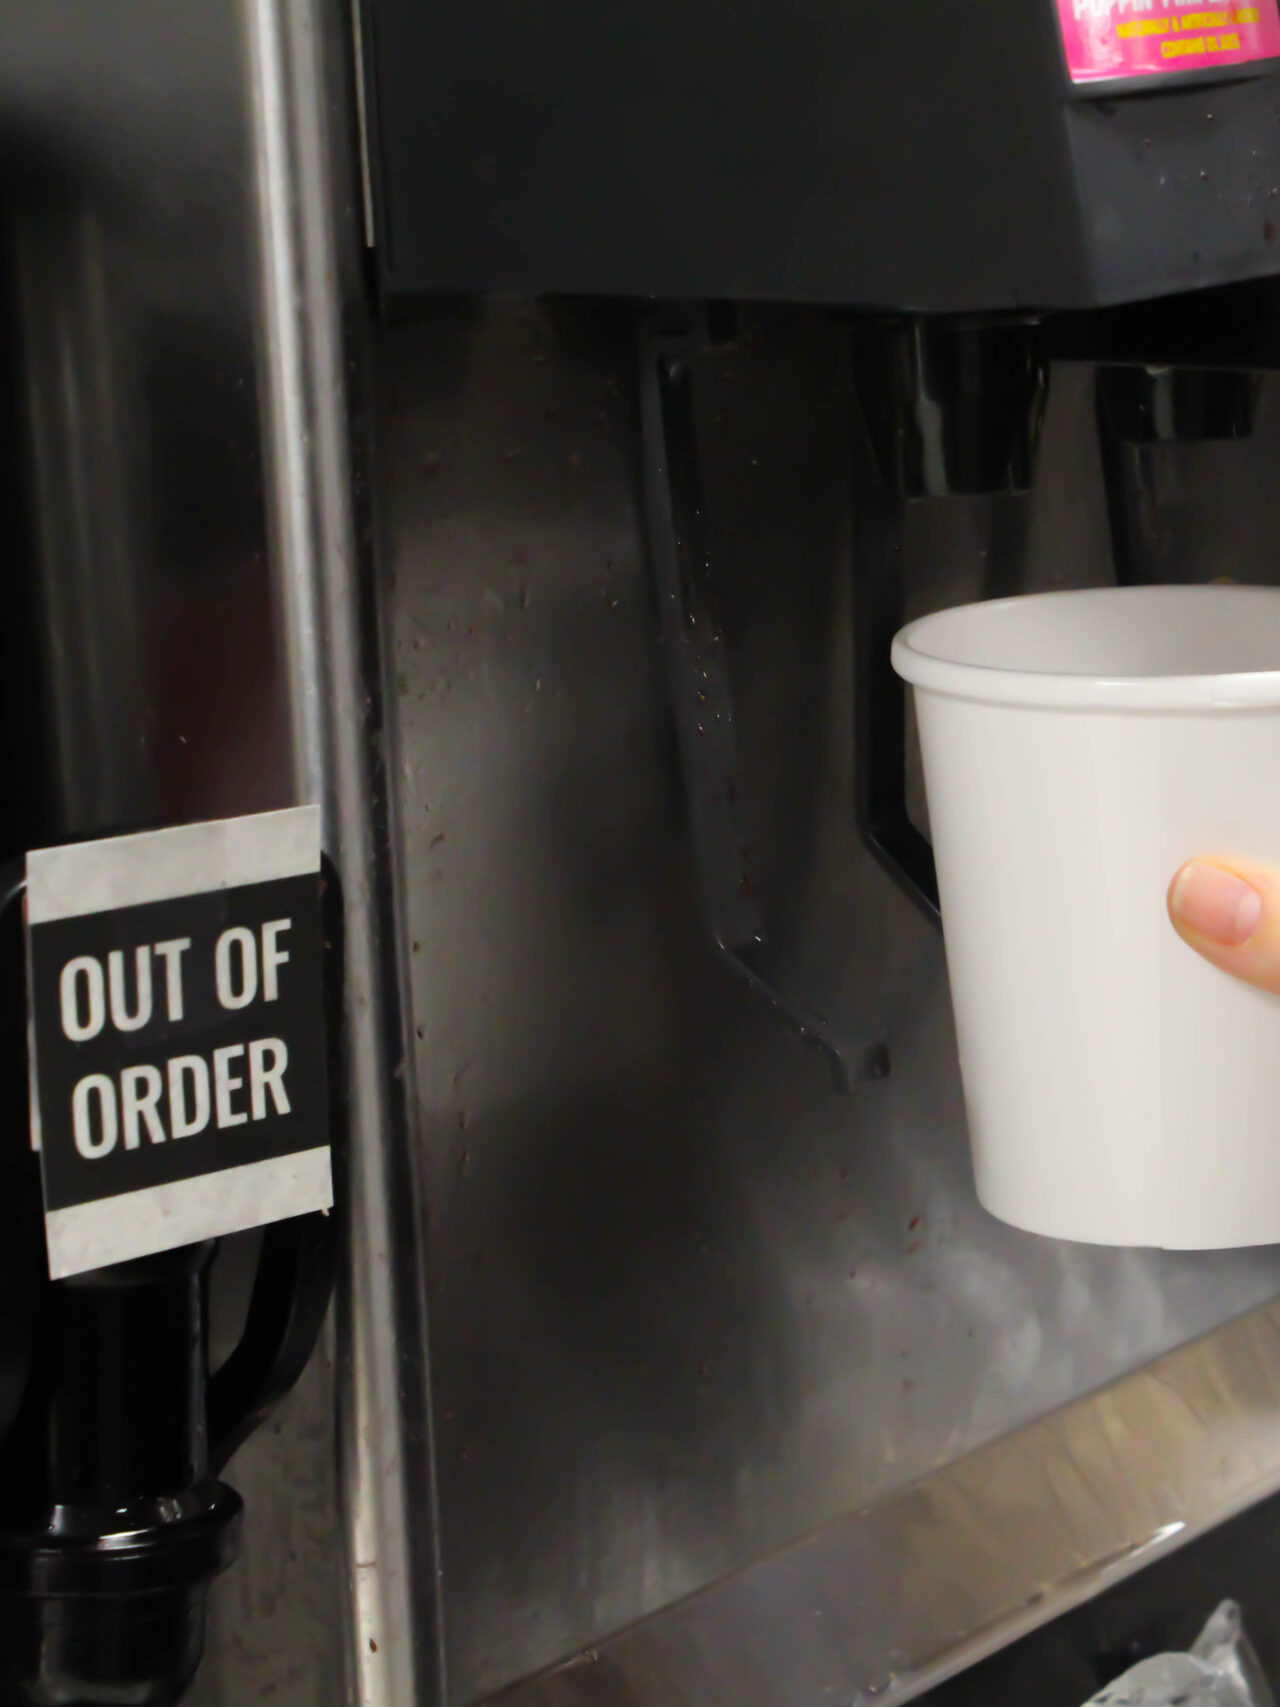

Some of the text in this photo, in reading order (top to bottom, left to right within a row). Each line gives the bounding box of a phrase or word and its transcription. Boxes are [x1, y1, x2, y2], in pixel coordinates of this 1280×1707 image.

[60, 918, 292, 1042] OUT OF
[72, 1036, 292, 1160] ORDER
